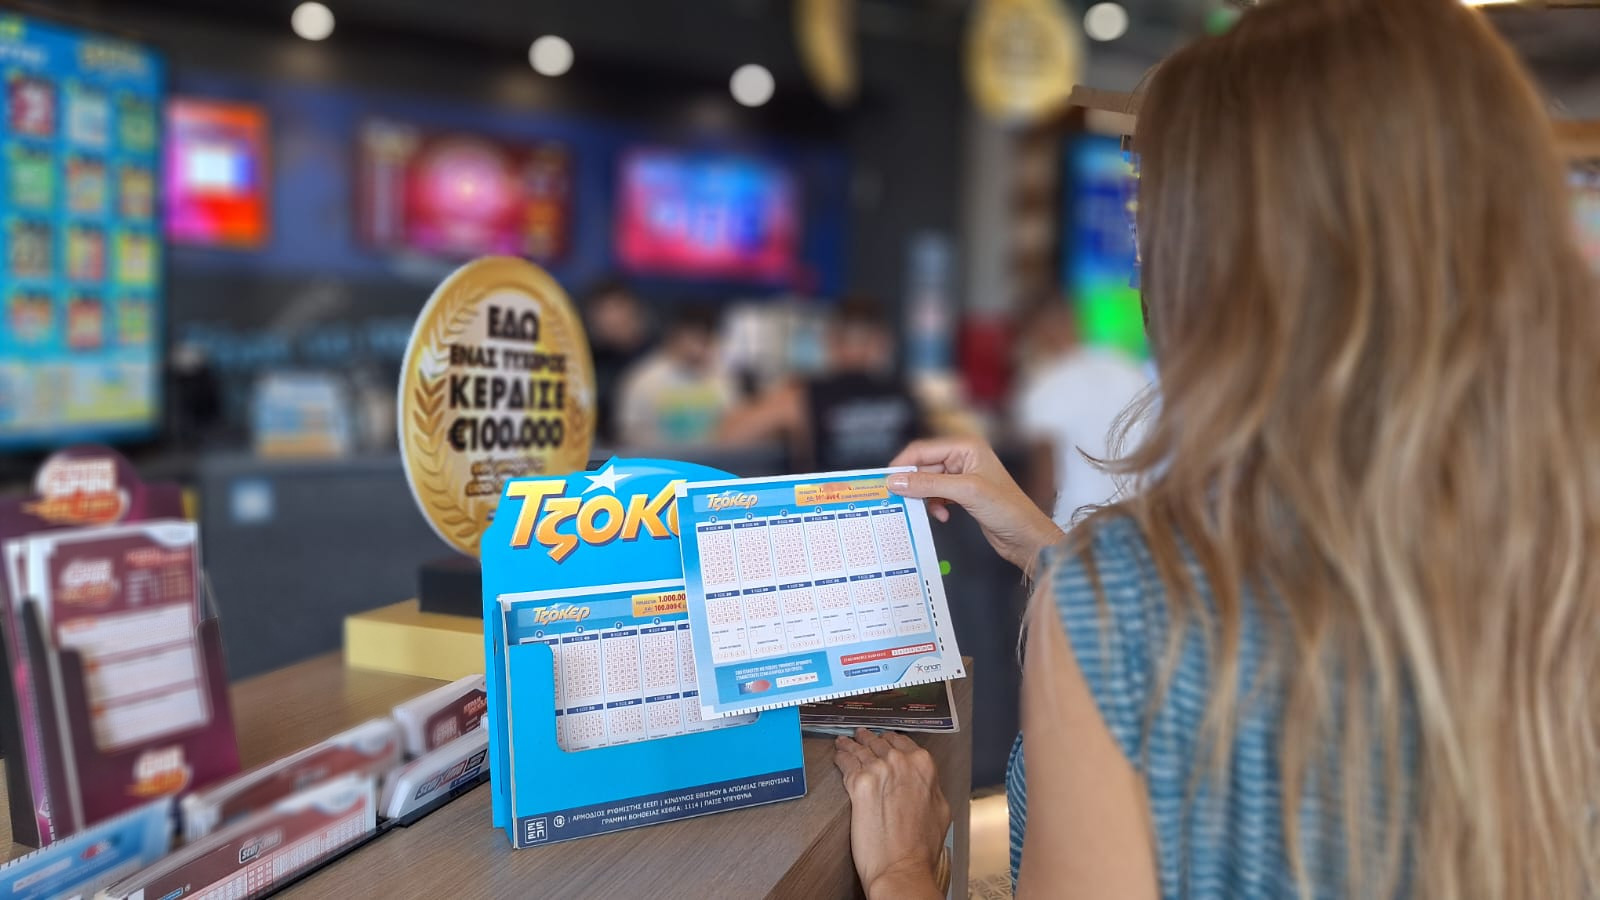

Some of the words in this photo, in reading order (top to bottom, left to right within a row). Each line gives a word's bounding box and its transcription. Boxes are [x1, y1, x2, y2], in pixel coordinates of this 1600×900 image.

[487, 306, 539, 341] ΕΔΩ
[450, 344, 497, 368] ΕΝΑΣ
[449, 374, 565, 410] ΚΕΡΔΙΣΕ
[447, 416, 565, 453] €100.000
[572, 810, 605, 821] ΑΡΜΟΔΙΟΣ
[606, 804, 641, 815] ΡΥΘΜΙΣΤΗΣ
[664, 794, 694, 805] ΚΙΝΔΥΝΟΣ
[695, 790, 721, 799] ΕΘΙΣΜΟΥ
[728, 782, 757, 793] ΑΠΩΛΕΙΑΣ
[757, 776, 790, 788] ΠΕΡΙΟΥΣΙΑΣ
[601, 815, 627, 825] ΓΡΑΜΜΗ
[628, 809, 659, 820] ΒΟΗΘΕΙΑΣ
[684, 801, 699, 810] 1114
[704, 797, 722, 807] ΠΑΙΞΕ
[722, 792, 752, 803] ΥΠΕΥΘΥΝΑ
